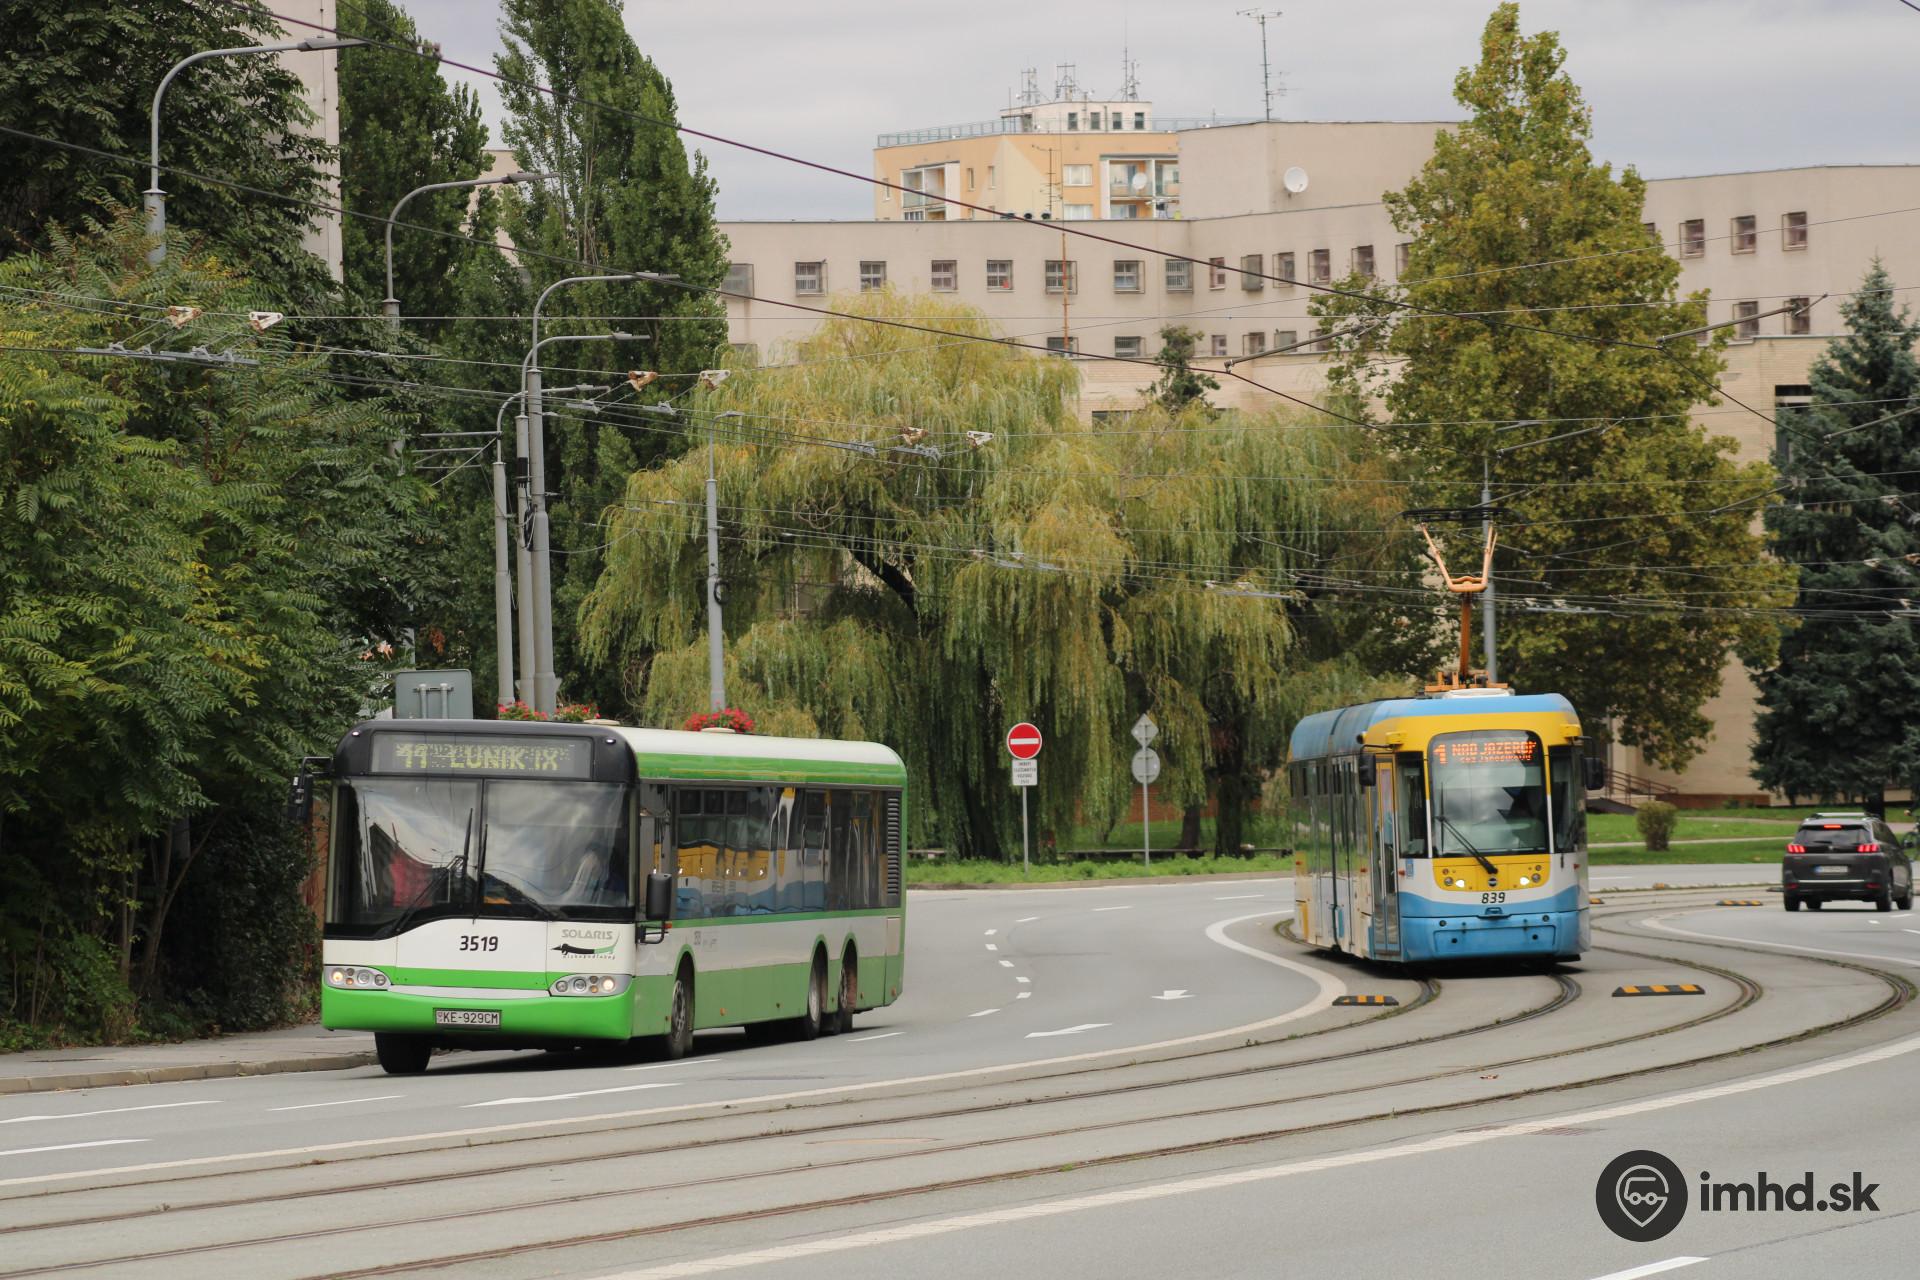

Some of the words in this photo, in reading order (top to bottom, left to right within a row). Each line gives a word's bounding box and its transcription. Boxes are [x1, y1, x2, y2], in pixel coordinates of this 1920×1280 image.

[1433, 744, 1448, 764] 1
[1451, 743, 1478, 756] NAD
[1481, 891, 1505, 904] 839
[561, 929, 613, 940] SOLARIS
[459, 935, 499, 951] 3519
[443, 1011, 498, 1024] KE-929CM
